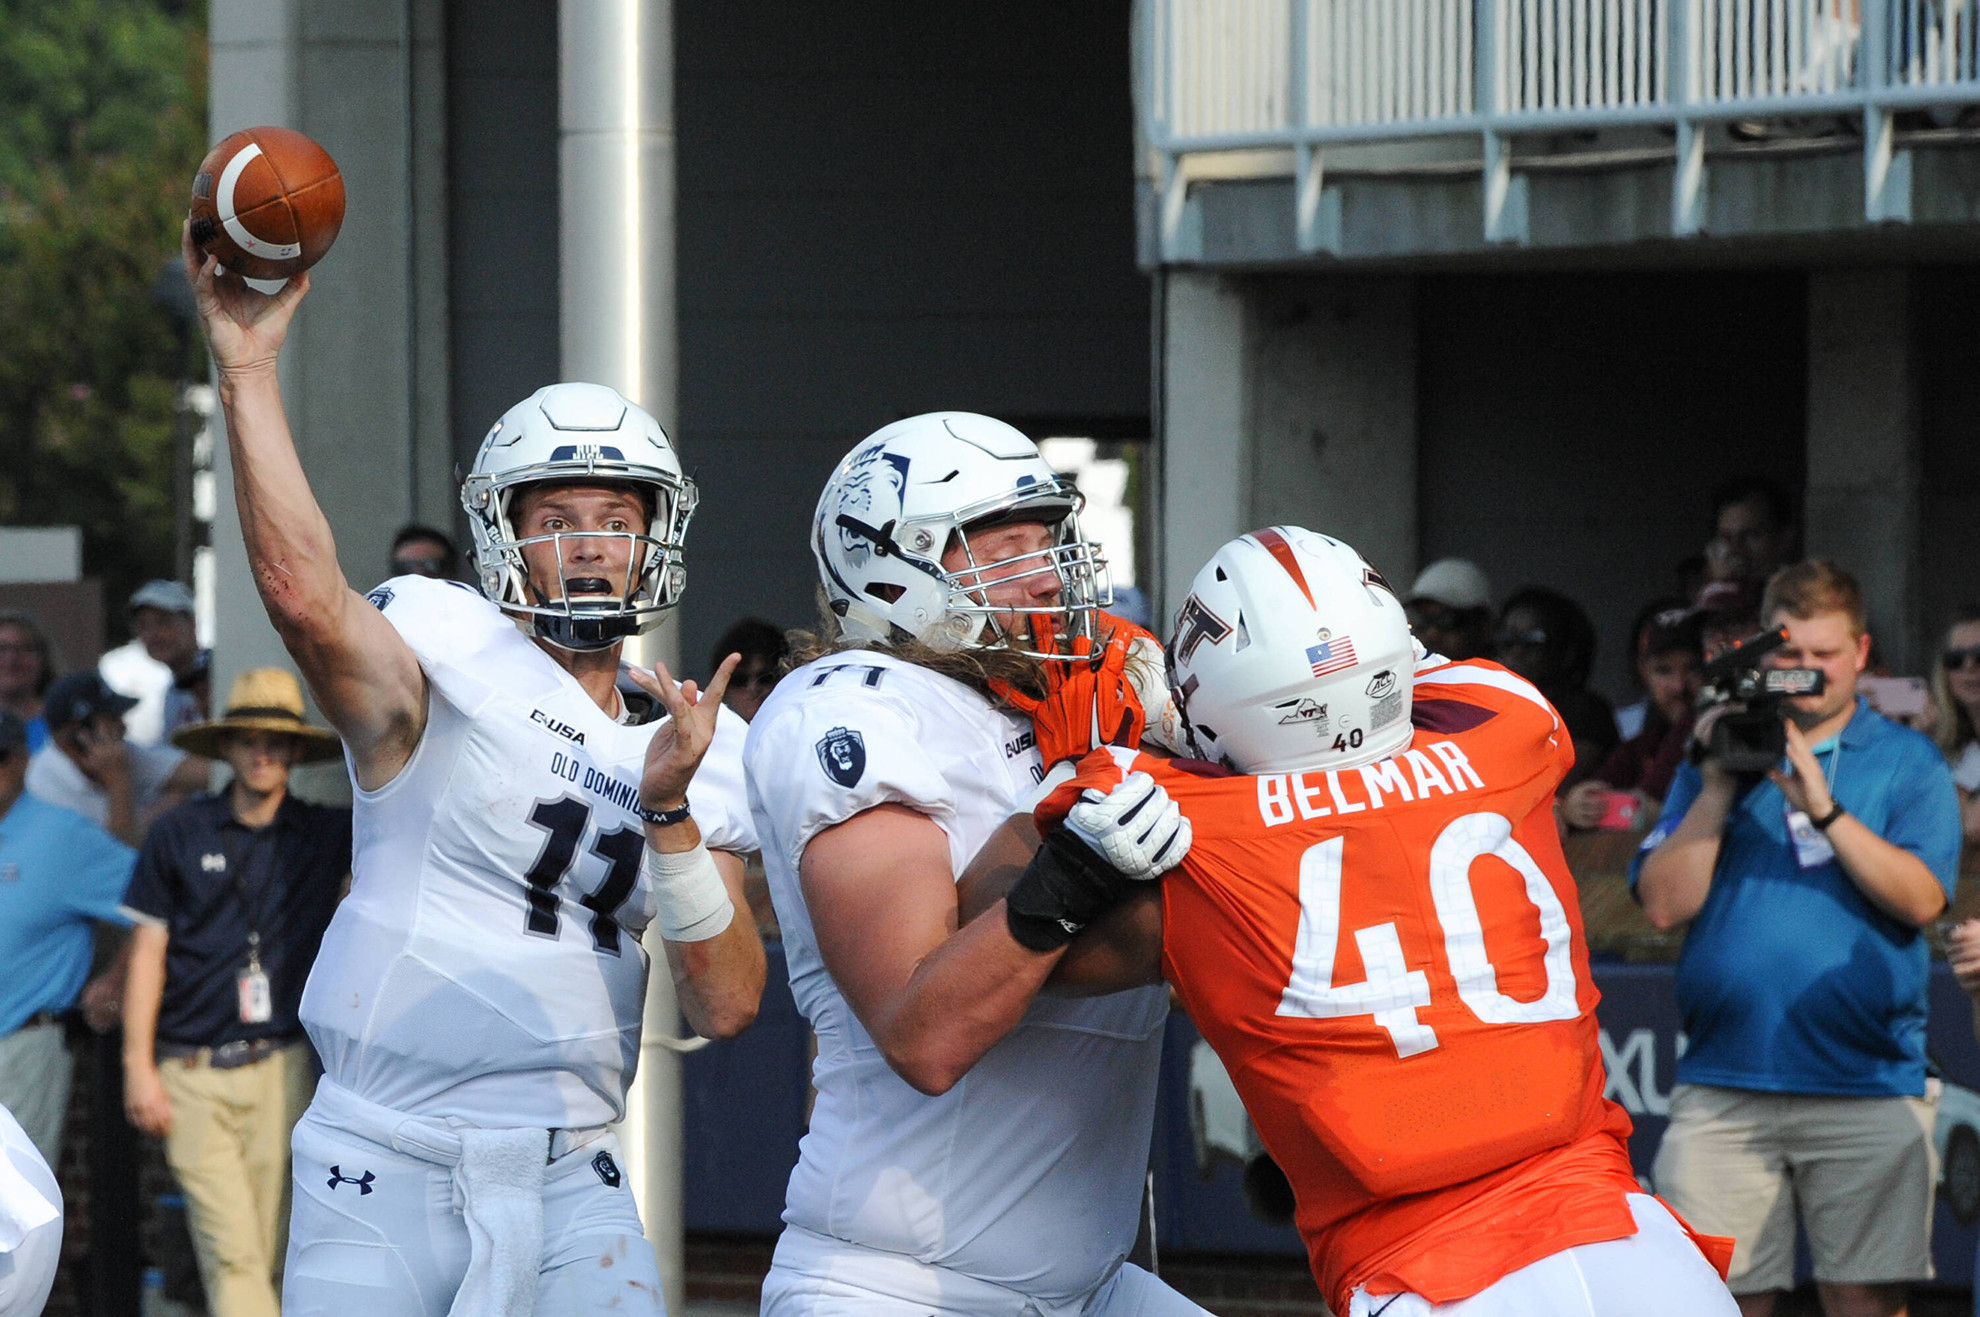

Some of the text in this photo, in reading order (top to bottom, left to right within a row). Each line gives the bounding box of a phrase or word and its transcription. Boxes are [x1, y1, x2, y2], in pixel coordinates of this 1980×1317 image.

[551, 751, 580, 782] OLD
[1331, 728, 1363, 752] 40
[1257, 741, 1485, 827] BELMAR
[523, 790, 647, 958] 11
[1275, 811, 1582, 1059] 40
